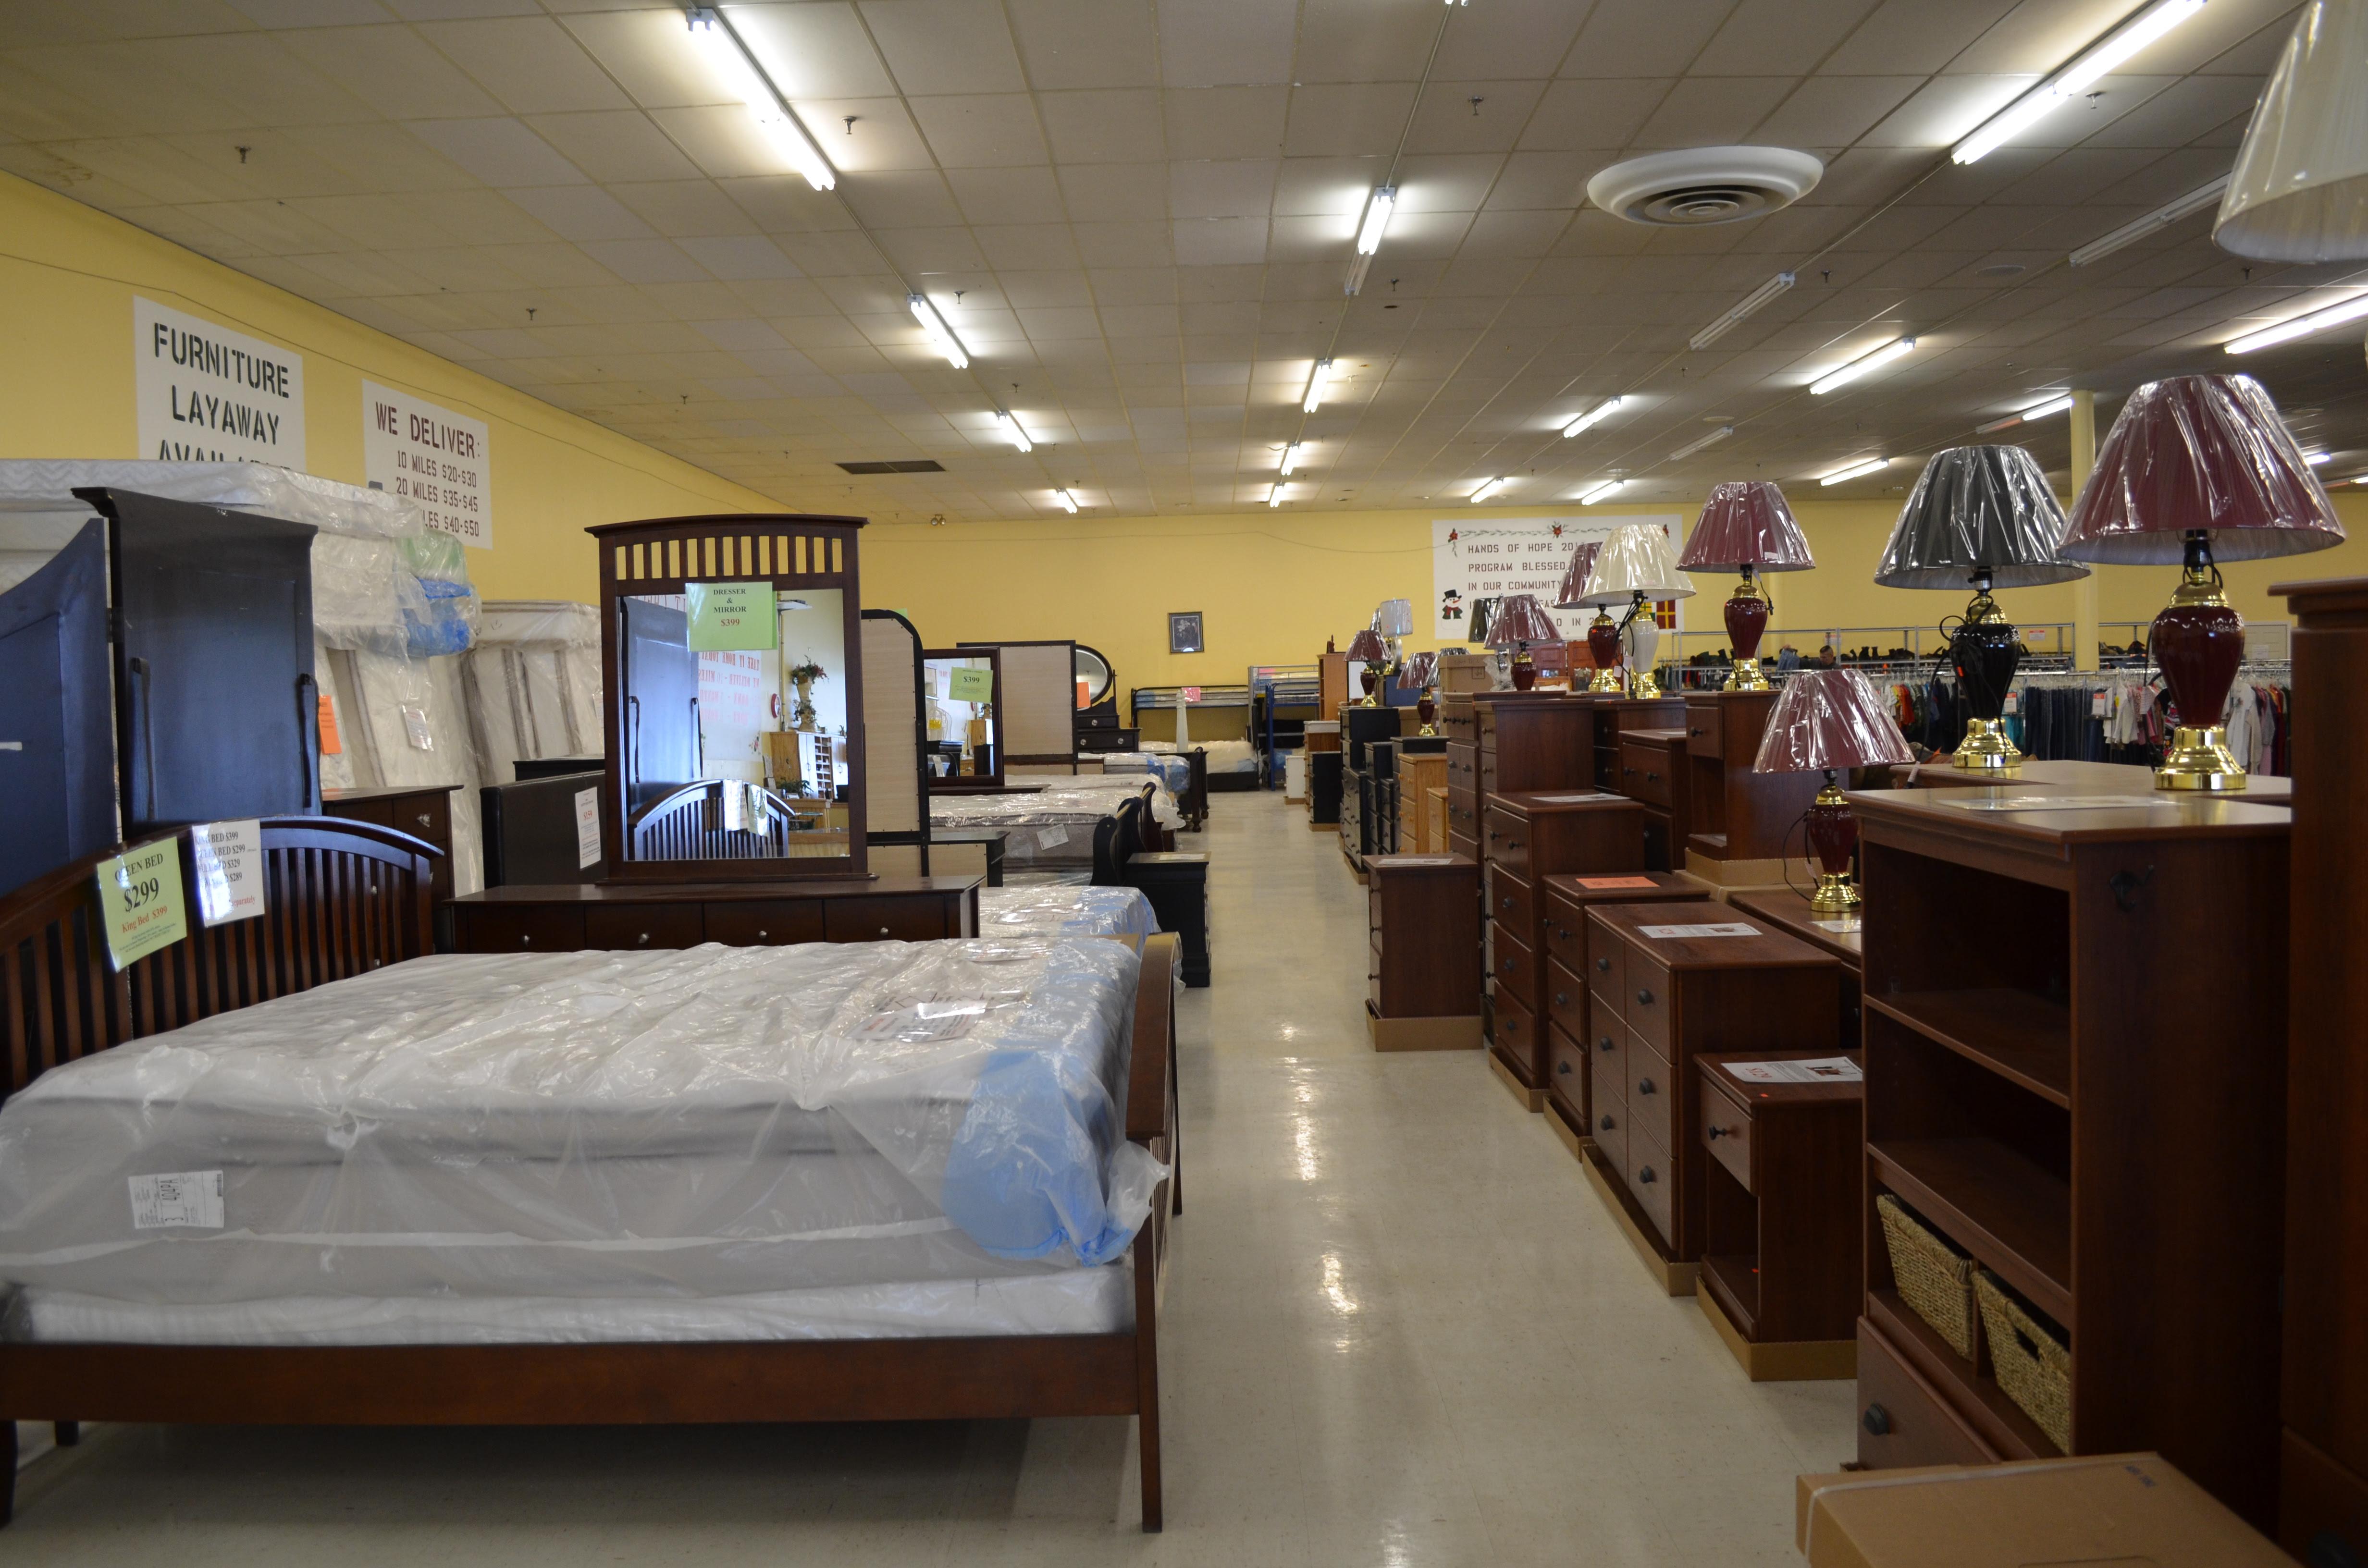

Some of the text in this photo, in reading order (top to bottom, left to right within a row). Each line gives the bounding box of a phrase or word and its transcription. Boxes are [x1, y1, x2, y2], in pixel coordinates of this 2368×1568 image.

[154, 322, 289, 399] FURNITURE
[172, 384, 279, 445] LAYAWAY
[375, 401, 481, 459] WE DELIVER:
[397, 450, 407, 469] 10
[412, 453, 437, 477] MILES
[396, 477, 408, 495] 20
[413, 480, 438, 503] MILES
[420, 509, 439, 529] LES
[1468, 544, 1499, 553] HANDS
[1508, 544, 1519, 552] OF
[1528, 543, 1553, 552] HOPE
[1468, 562, 1566, 572] PROGRAM BLESSED
[1468, 580, 1562, 591] IN OUR COMMUNITY
[1572, 618, 1581, 626] IN
[211, 833, 224, 843] BED
[225, 831, 238, 841] $399
[218, 845, 231, 857] BED
[232, 844, 246, 855] $299
[145, 853, 163, 870] BED
[227, 858, 240, 869] $329
[229, 871, 243, 882] $289
[124, 878, 160, 913] $299
[122, 905, 168, 933] King Bed $399
